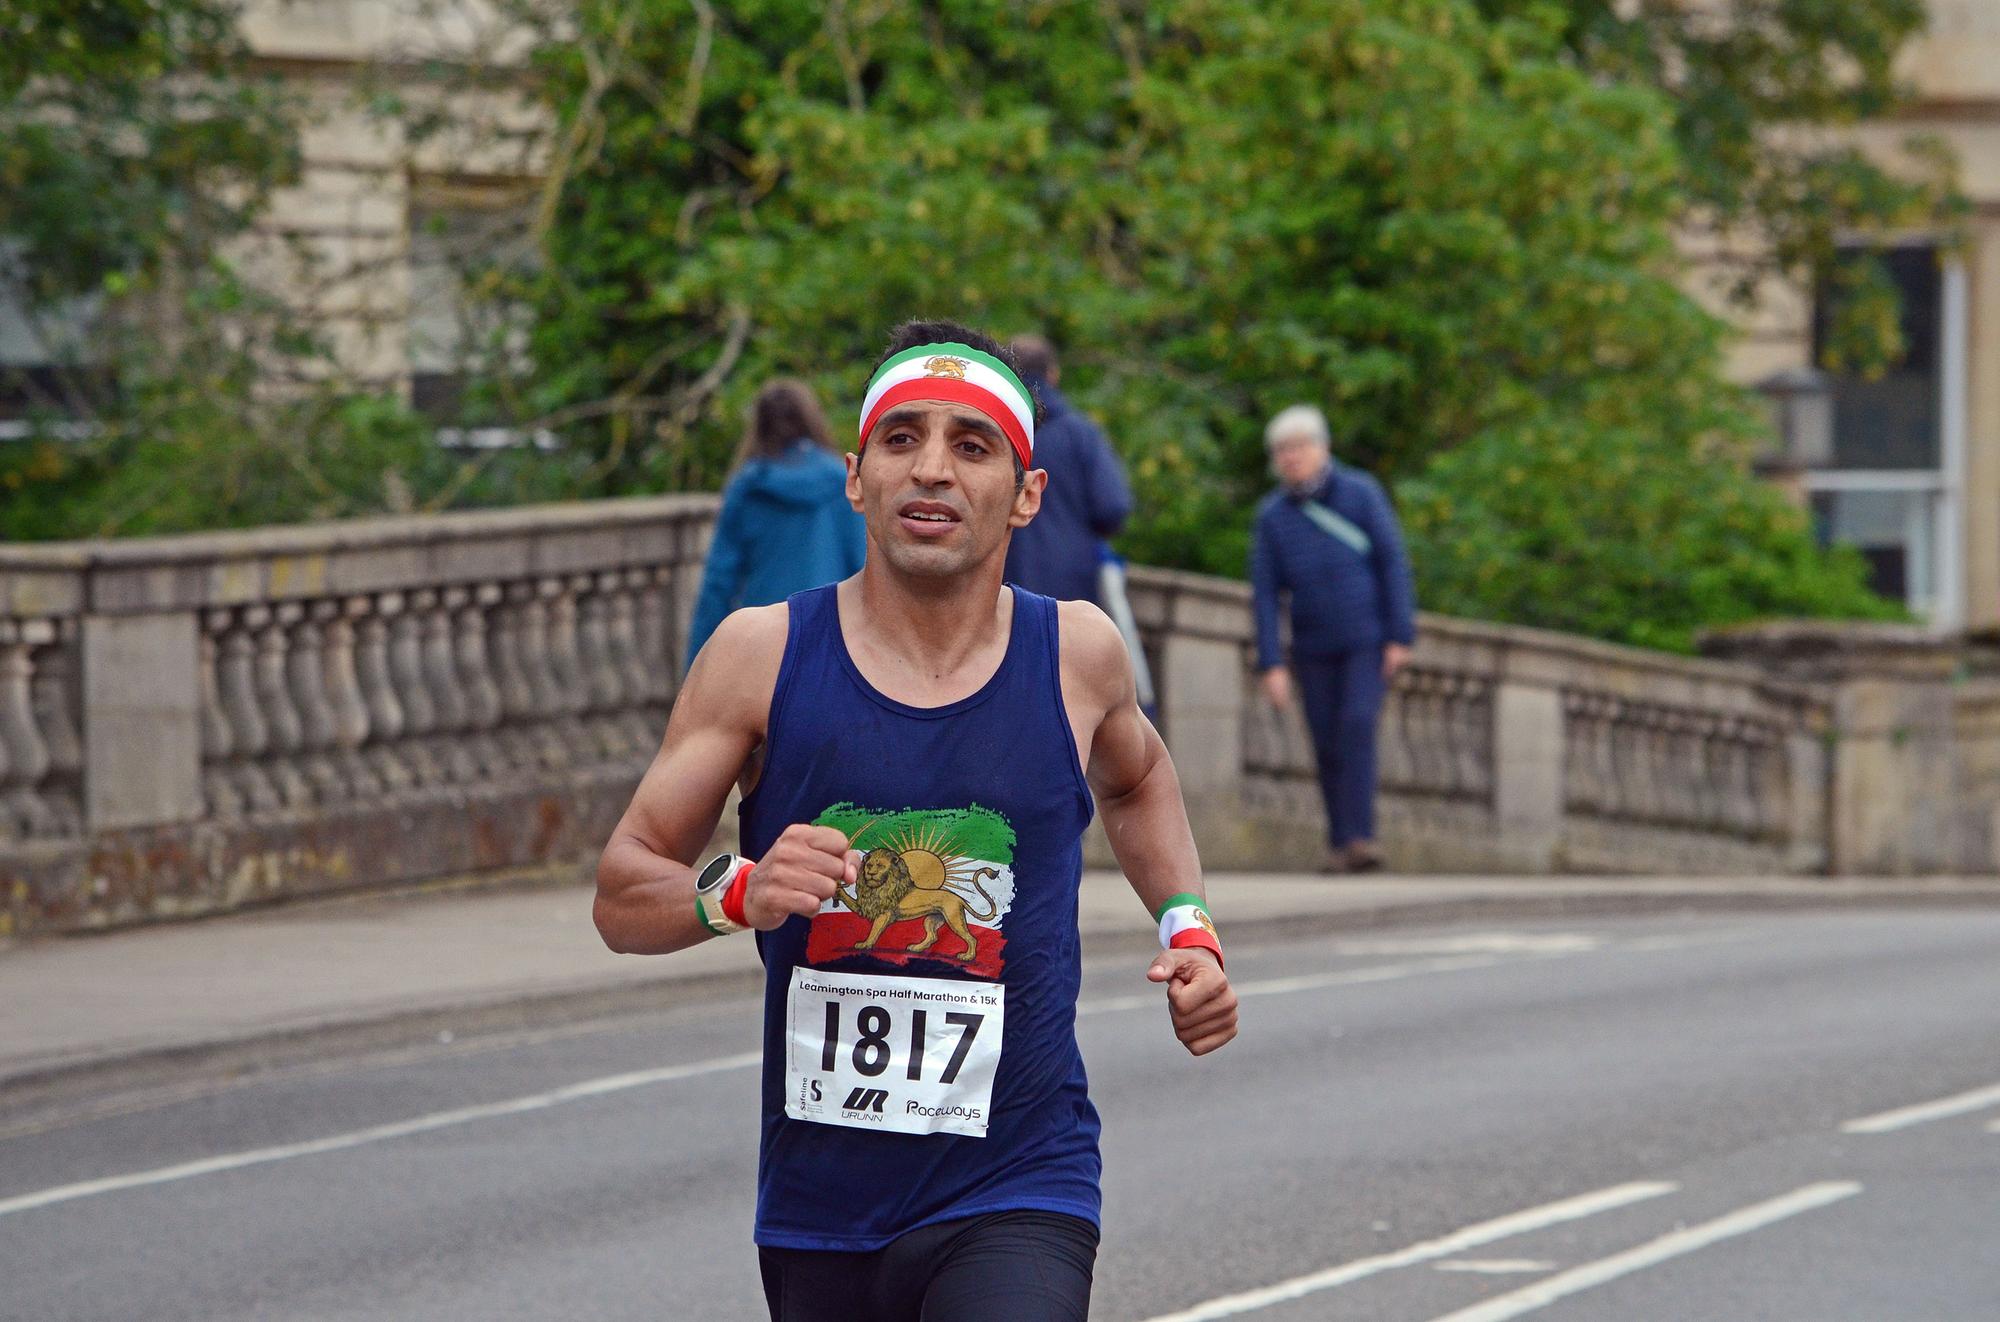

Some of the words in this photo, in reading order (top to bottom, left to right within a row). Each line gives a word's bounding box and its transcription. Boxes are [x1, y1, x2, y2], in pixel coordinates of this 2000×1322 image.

[800, 981, 863, 996] Leamington
[866, 988, 886, 999] Spa
[889, 989, 911, 999] Half
[913, 991, 967, 1003] Marathon
[969, 995, 978, 1004] &
[980, 995, 998, 1006] 15K
[821, 1001, 985, 1084] 1817
[800, 1077, 808, 1111] Safeline
[906, 1099, 981, 1120] Raceways
